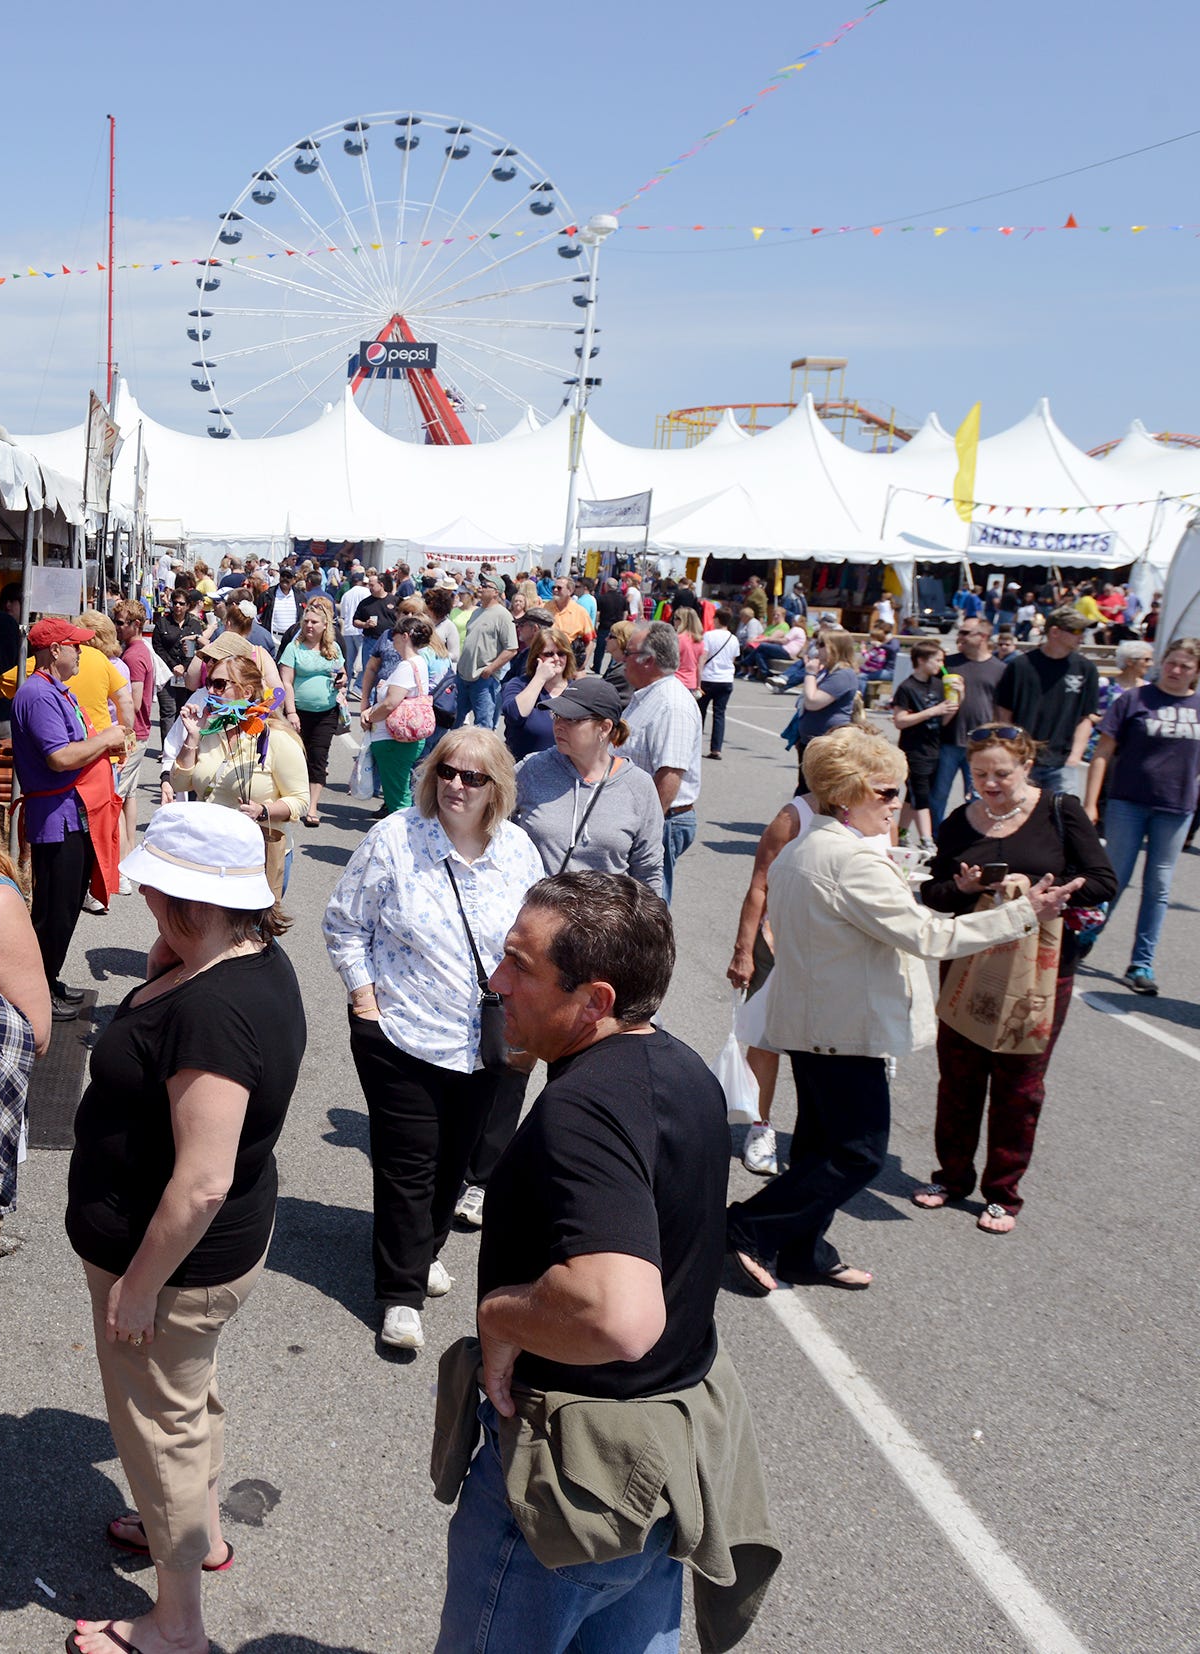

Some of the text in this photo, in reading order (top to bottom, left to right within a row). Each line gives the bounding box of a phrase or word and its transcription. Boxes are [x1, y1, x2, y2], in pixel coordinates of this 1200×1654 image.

[388, 347, 429, 363] pepsi
[979, 526, 1022, 547] ARTS
[1044, 533, 1111, 552] CRAFTS
